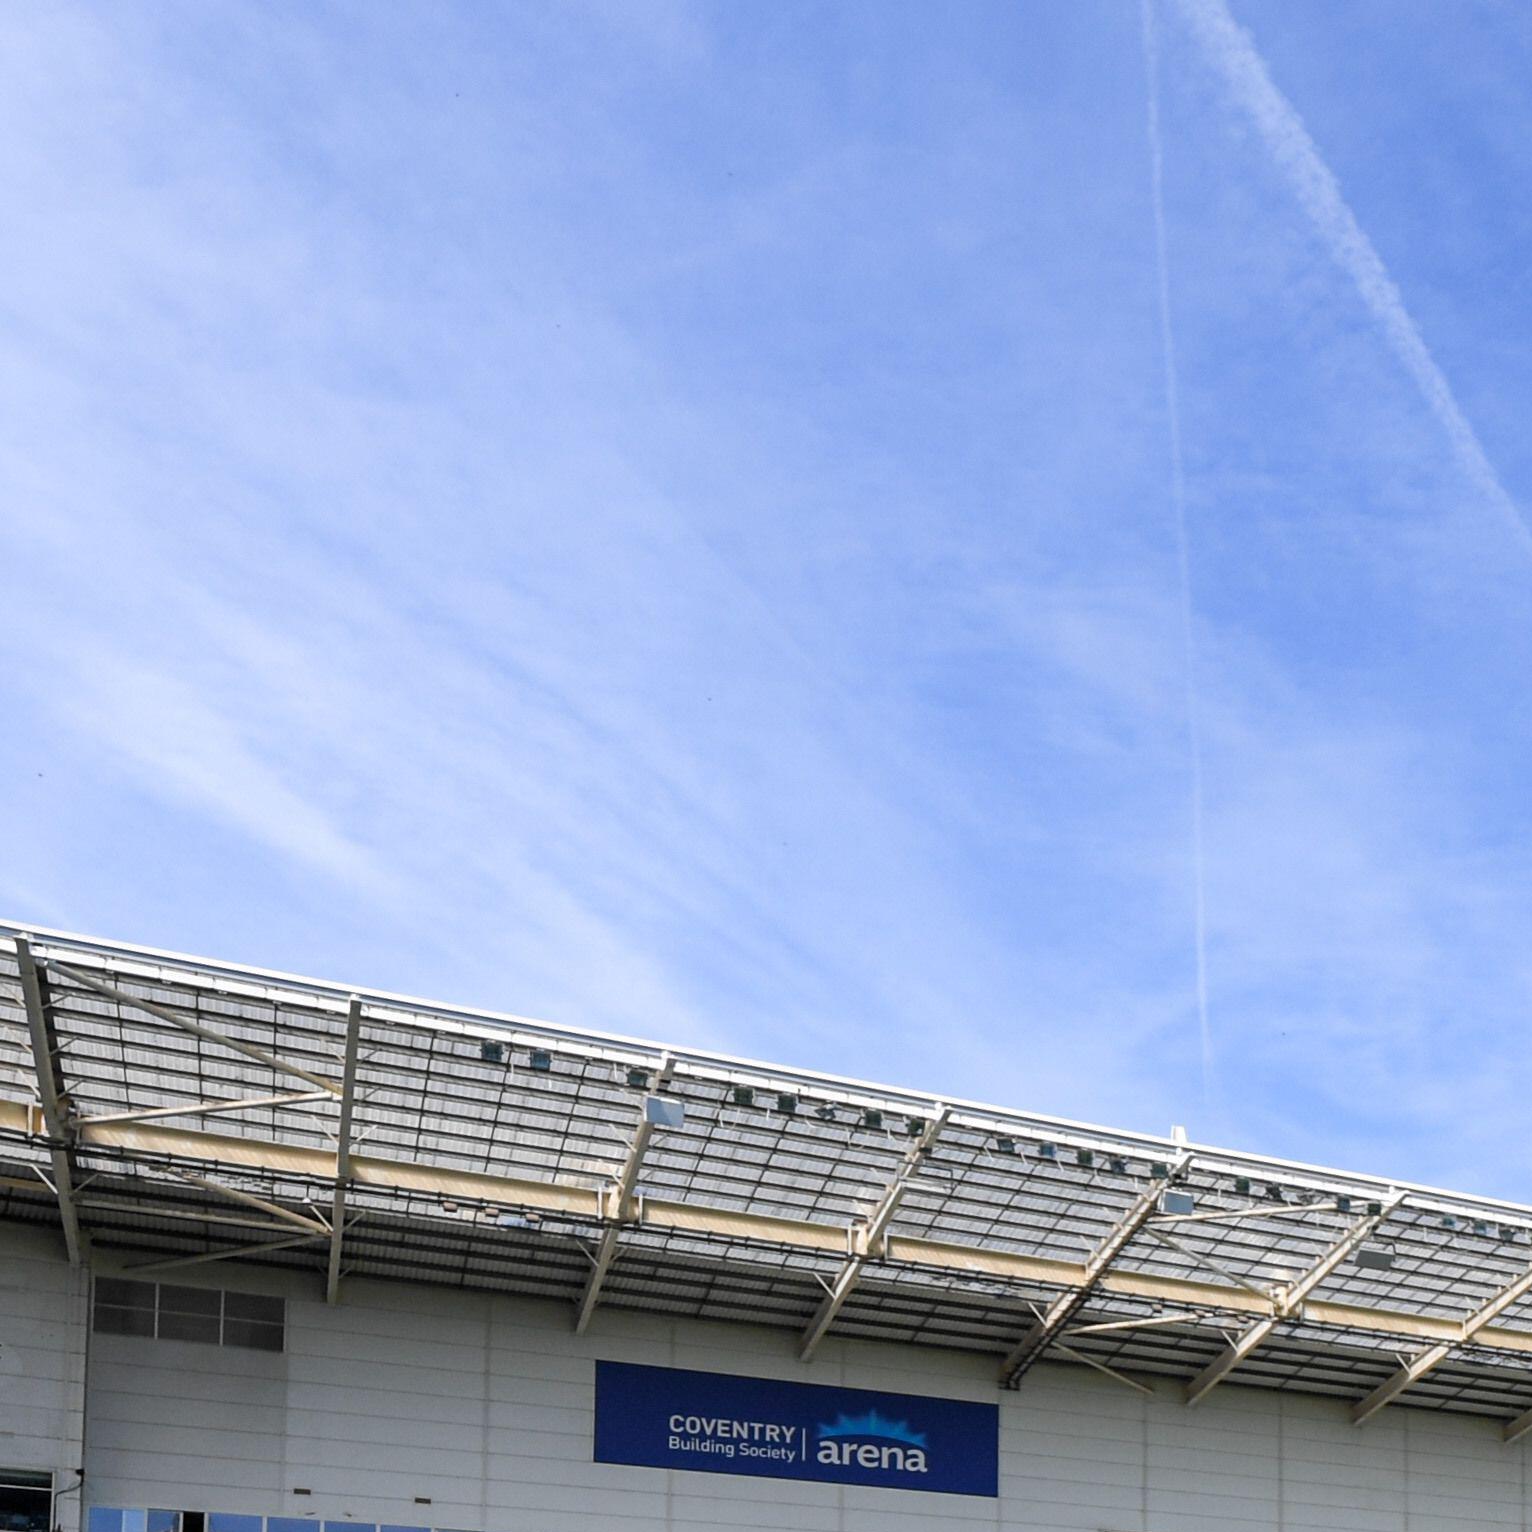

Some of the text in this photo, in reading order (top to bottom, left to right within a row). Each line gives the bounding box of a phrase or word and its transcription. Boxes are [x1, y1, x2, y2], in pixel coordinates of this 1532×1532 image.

[669, 1414, 796, 1443] COVENTRY
[669, 1436, 796, 1463] Building Society
[817, 1440, 928, 1473] arena
